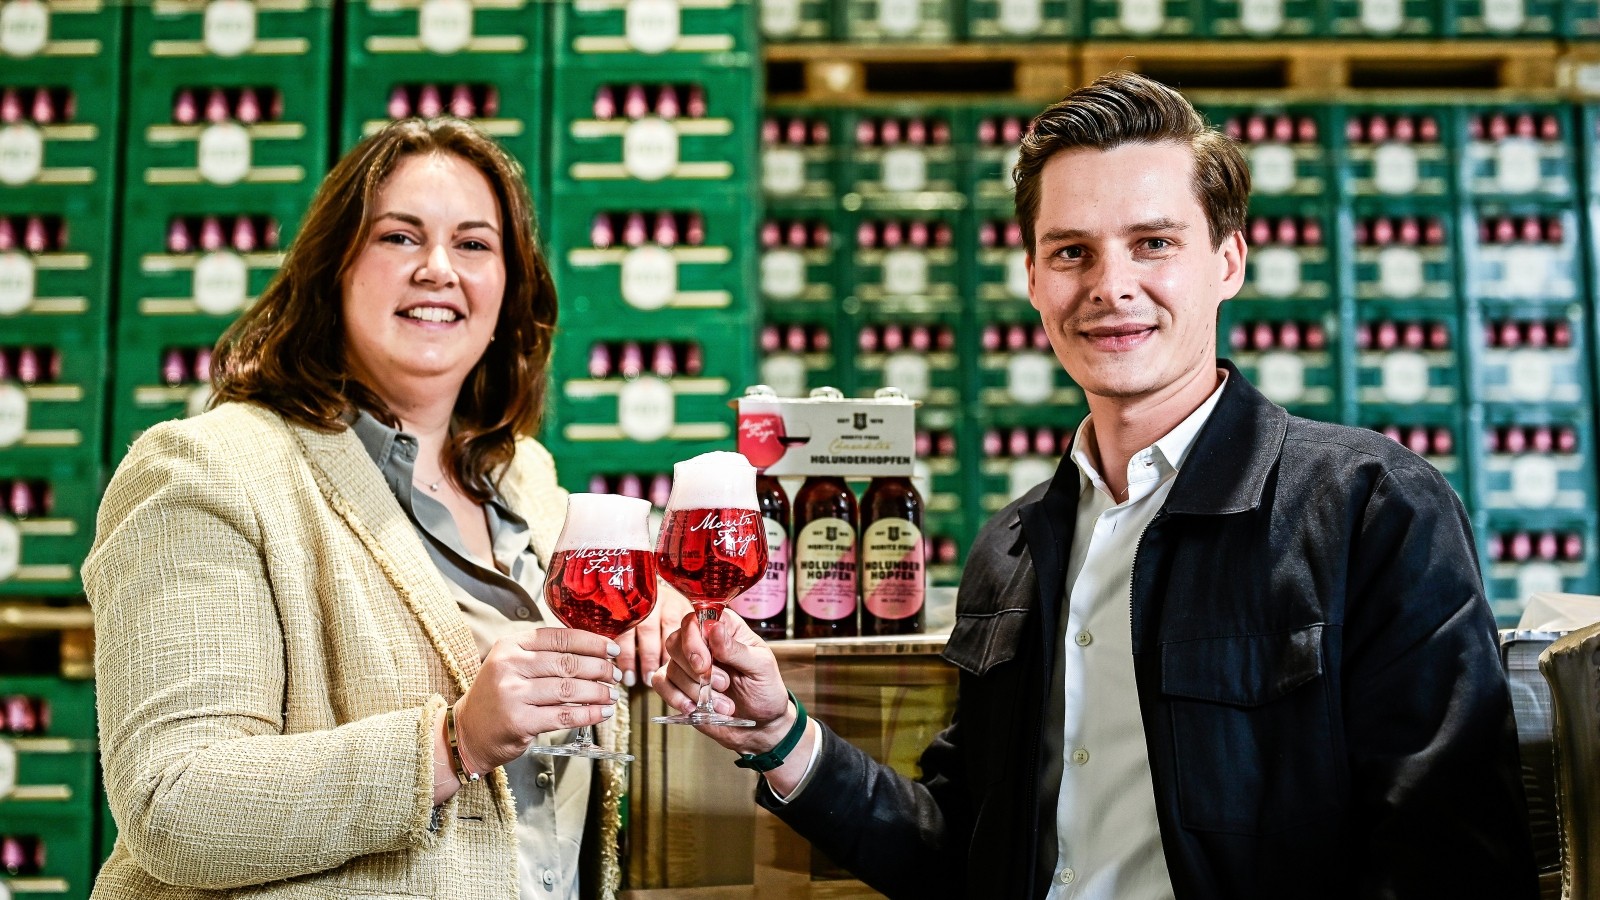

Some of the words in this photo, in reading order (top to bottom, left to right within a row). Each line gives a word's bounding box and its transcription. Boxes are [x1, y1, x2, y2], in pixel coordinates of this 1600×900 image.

[810, 455, 911, 465] HOLUNDERHOPFEN
[690, 511, 757, 532] Moritz
[713, 527, 759, 557] Fiege
[565, 541, 638, 561] Moritz
[583, 556, 635, 586] Fiege
[800, 561, 856, 572] HOLUNDER
[865, 561, 920, 572] HOLUNDER
[807, 571, 851, 581] HOPFEN
[871, 571, 915, 581] HOPFEN
